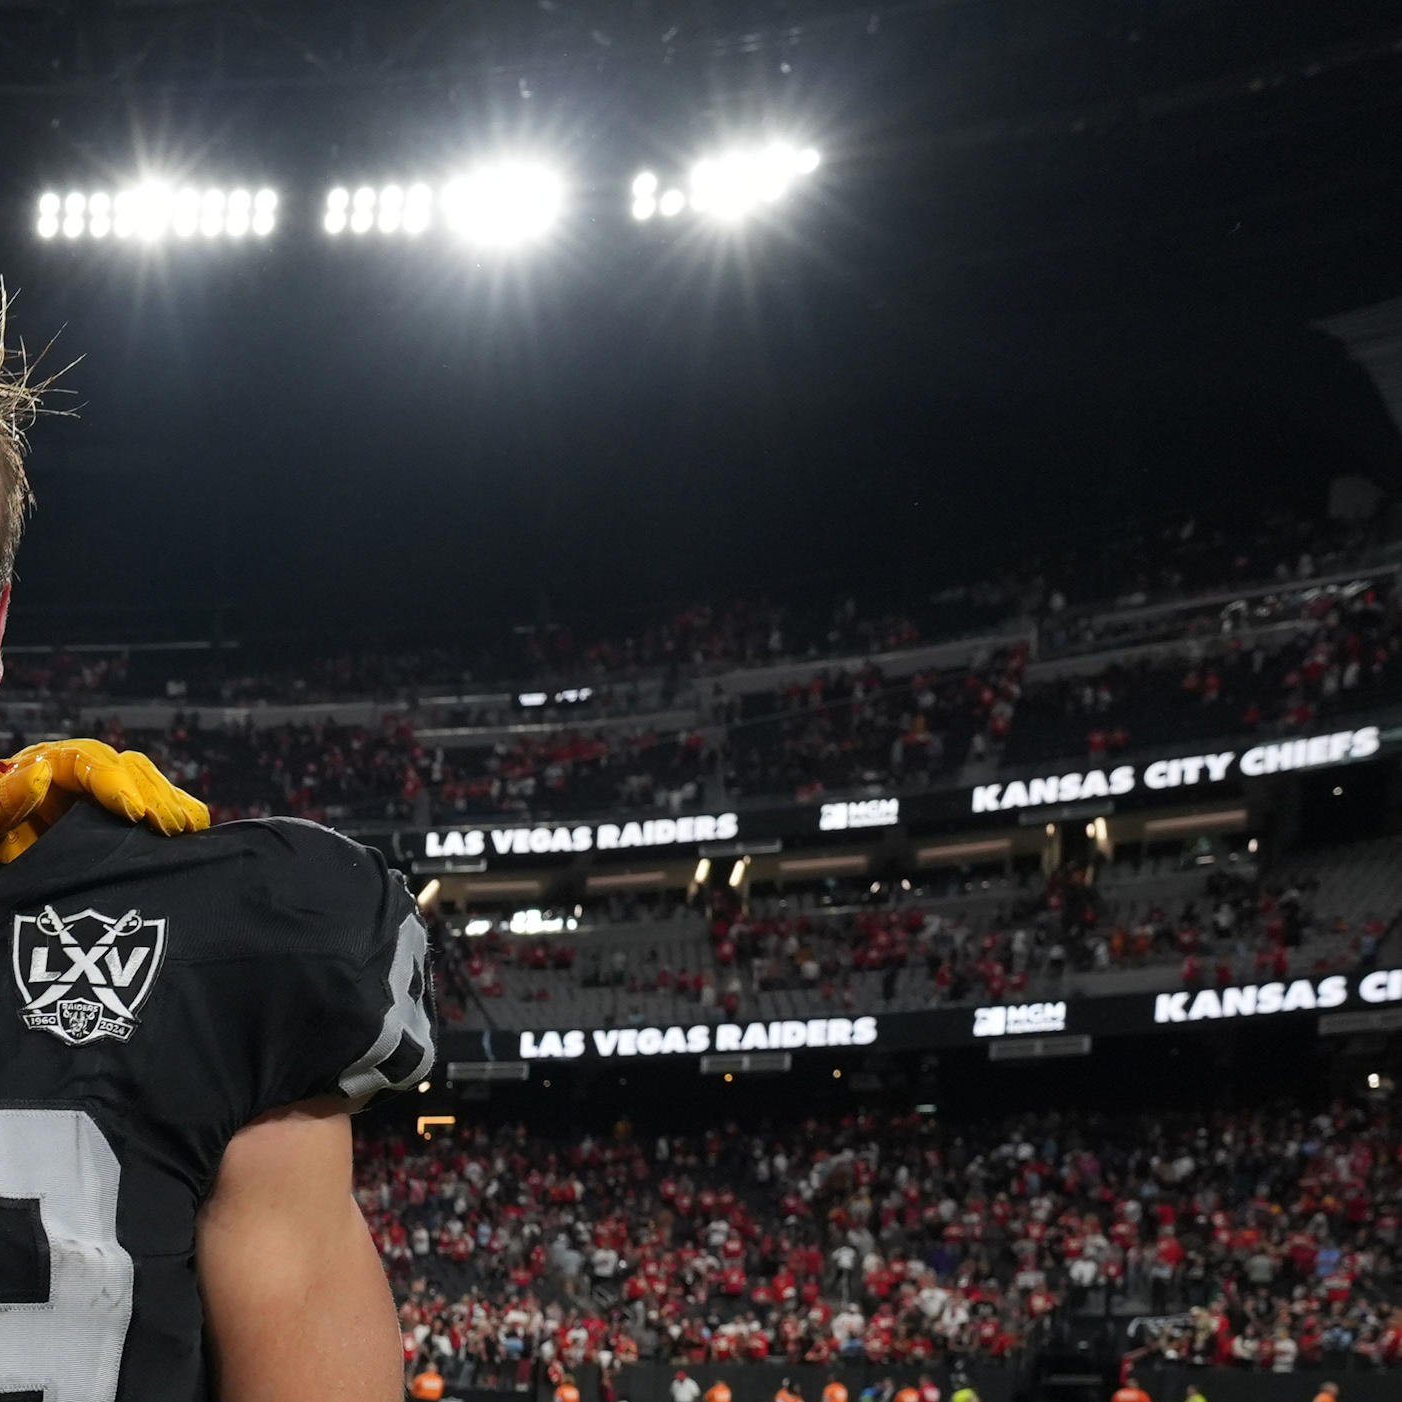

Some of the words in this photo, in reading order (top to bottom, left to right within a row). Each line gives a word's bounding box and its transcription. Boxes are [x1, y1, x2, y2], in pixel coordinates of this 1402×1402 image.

[971, 765, 1136, 813] KANSAS
[1143, 751, 1235, 789] CITY
[1239, 725, 1380, 777] CHIEFS
[425, 830, 485, 858] LAS
[490, 825, 593, 855] VEGAS
[596, 812, 739, 850] RAIDERS
[28, 946, 150, 988] LXV
[61, 1002, 100, 1013] RAIDERS
[1154, 974, 1348, 1024] KANSAS
[30, 1016, 57, 1026] 1960
[99, 1021, 126, 1036] 2024
[519, 1030, 586, 1059] LAS
[592, 1025, 710, 1057] VEGAS
[715, 1016, 878, 1051] RAIDERS
